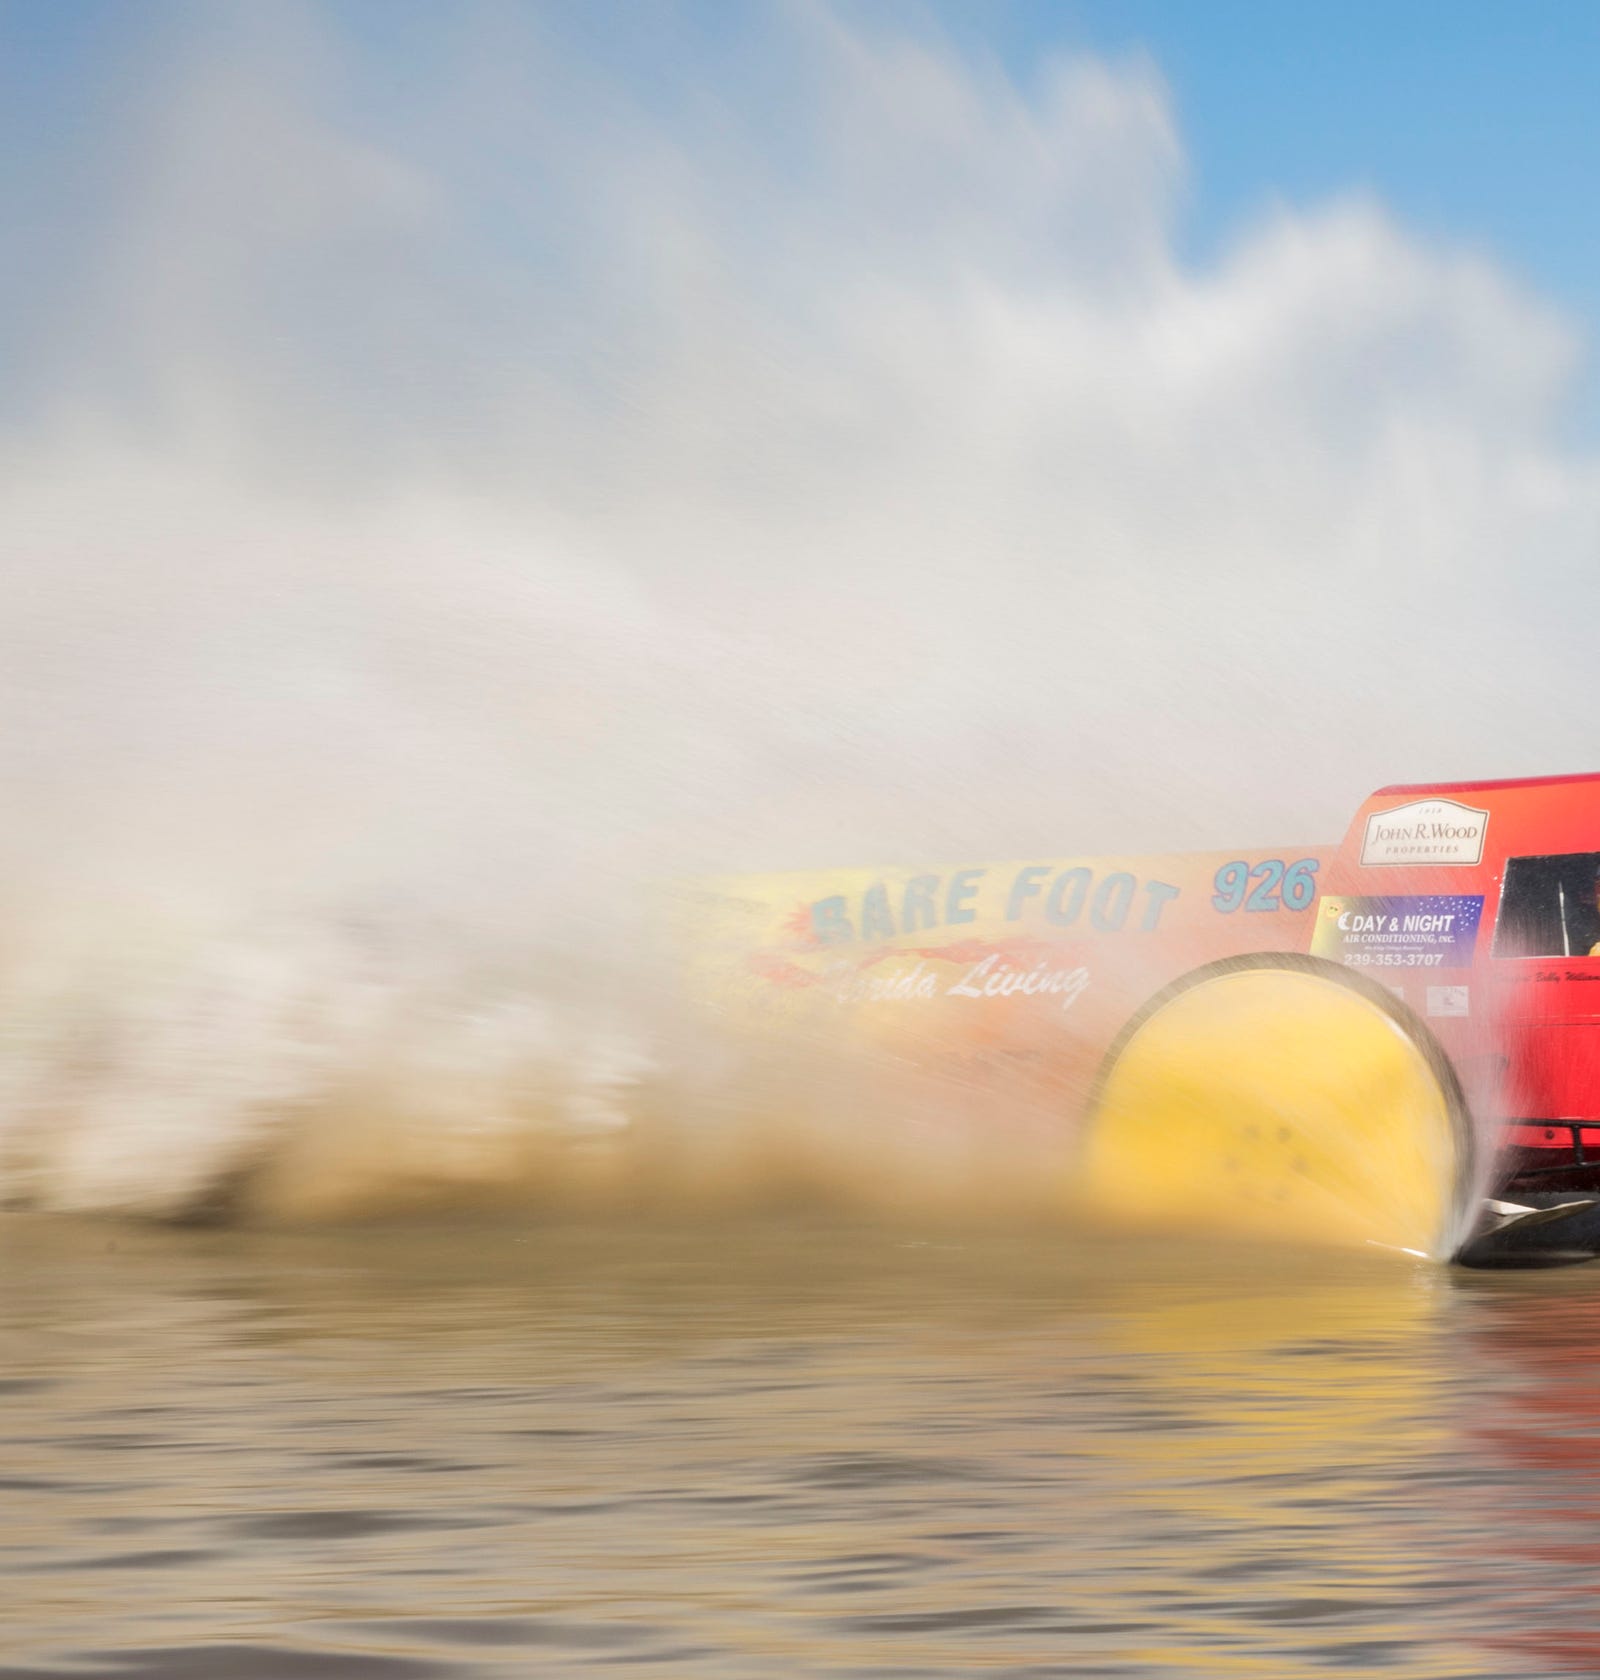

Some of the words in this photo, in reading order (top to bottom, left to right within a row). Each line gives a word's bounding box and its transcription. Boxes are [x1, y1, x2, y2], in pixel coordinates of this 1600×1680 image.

[1371, 824, 1415, 846] JOHN
[1386, 845, 1459, 855] PROPERTIES
[1210, 858, 1320, 914] 926
[811, 869, 986, 944] BARE
[1006, 866, 1181, 933] FOOT
[1352, 915, 1387, 932] DAY
[1389, 917, 1399, 932] &
[1403, 915, 1455, 932] NIGHT
[1343, 934, 1360, 943] AIR
[1344, 953, 1444, 966] 239-353-3707
[947, 953, 1092, 1010] Living
